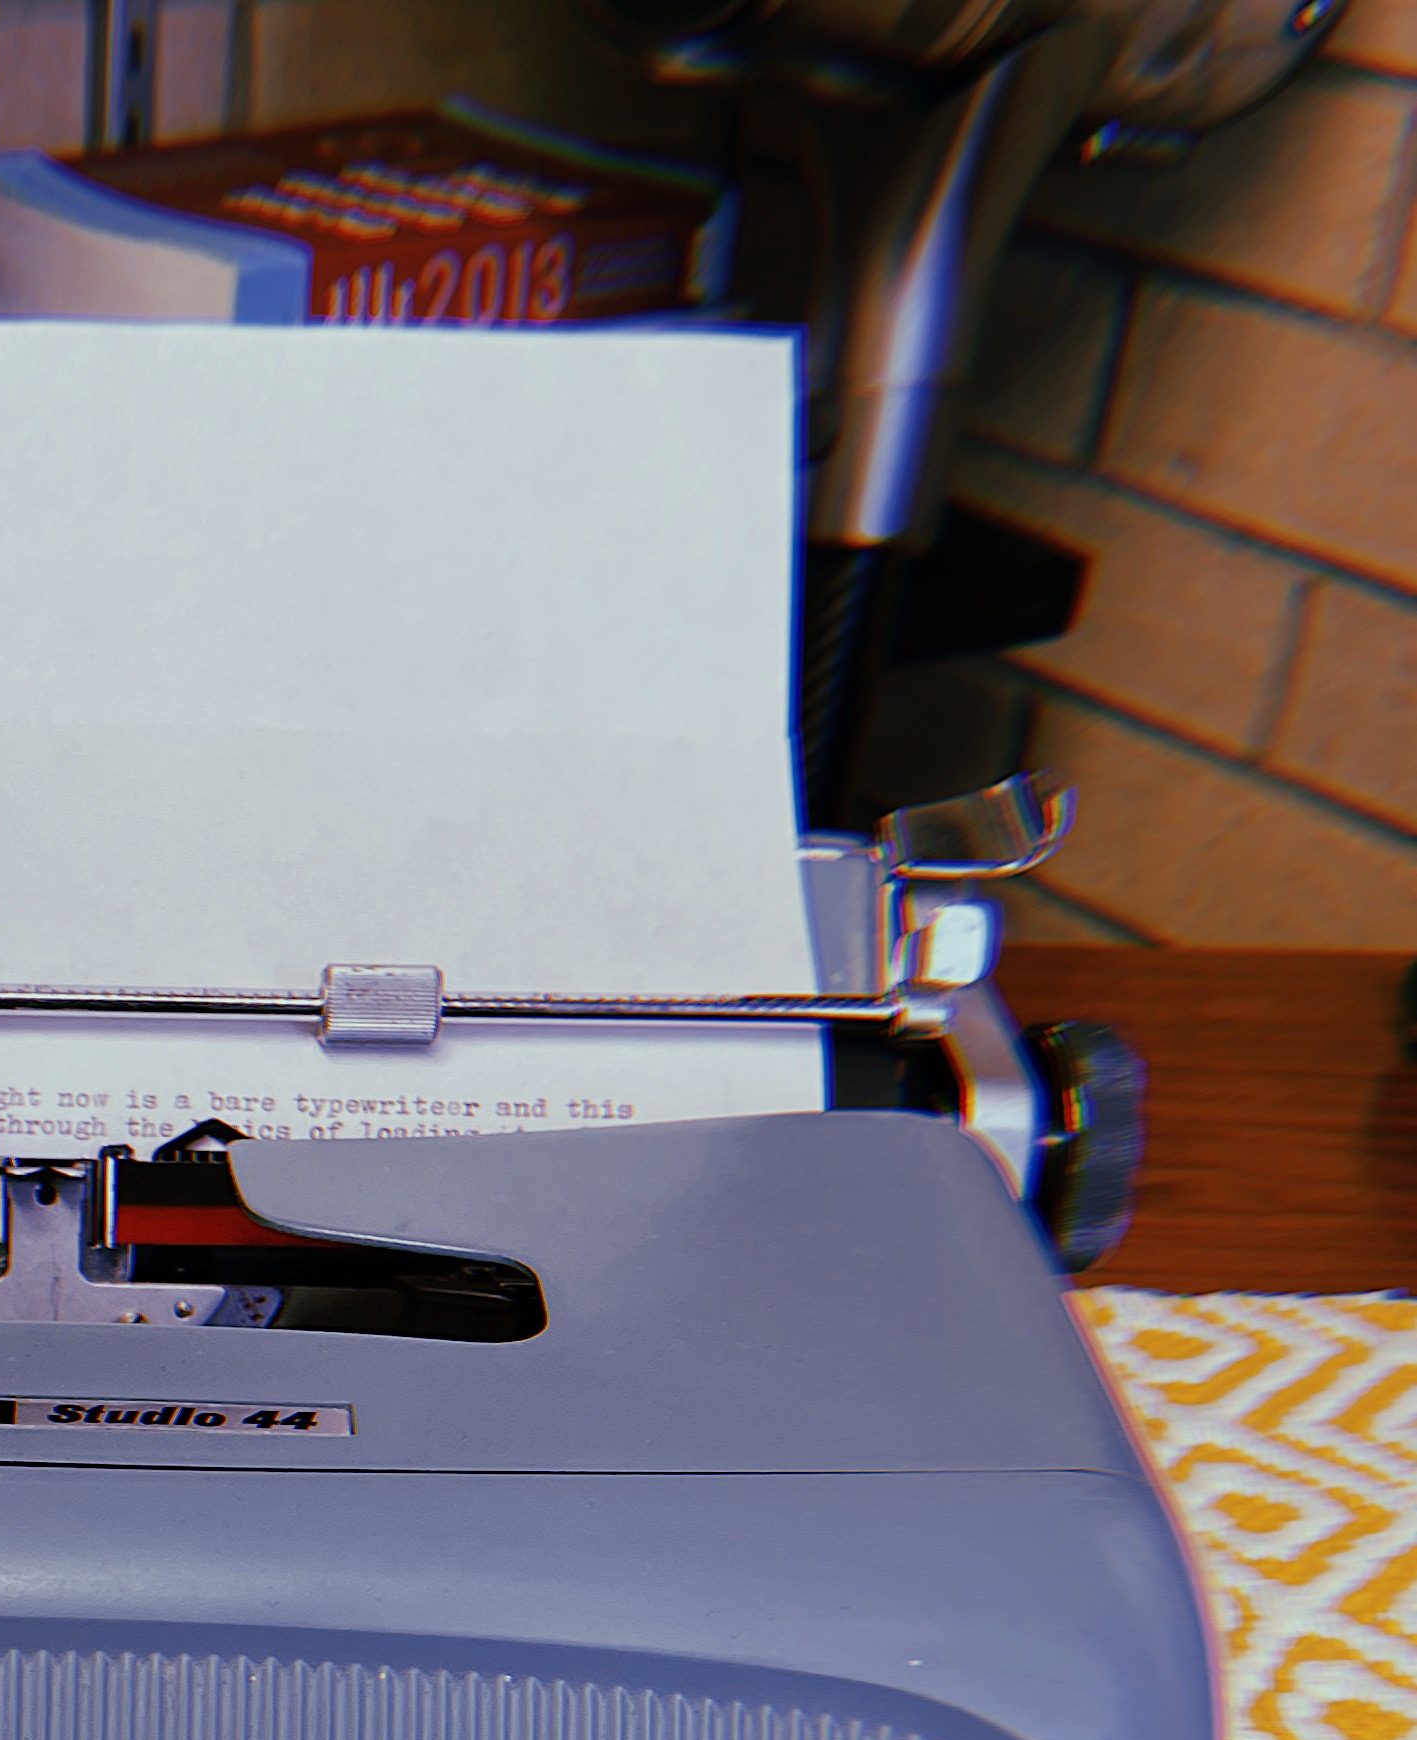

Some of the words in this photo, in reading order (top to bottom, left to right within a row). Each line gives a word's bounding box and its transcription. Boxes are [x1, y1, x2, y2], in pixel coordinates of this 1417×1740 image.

[56, 1091, 111, 1109] now
[125, 1089, 160, 1111] is
[174, 1093, 193, 1110] a
[208, 1090, 278, 1112] bare
[495, 1098, 549, 1119] and
[566, 1097, 635, 1120] this
[126, 1115, 175, 1138] the
[46, 1403, 229, 1428] Studio
[241, 1410, 321, 1431] 44
